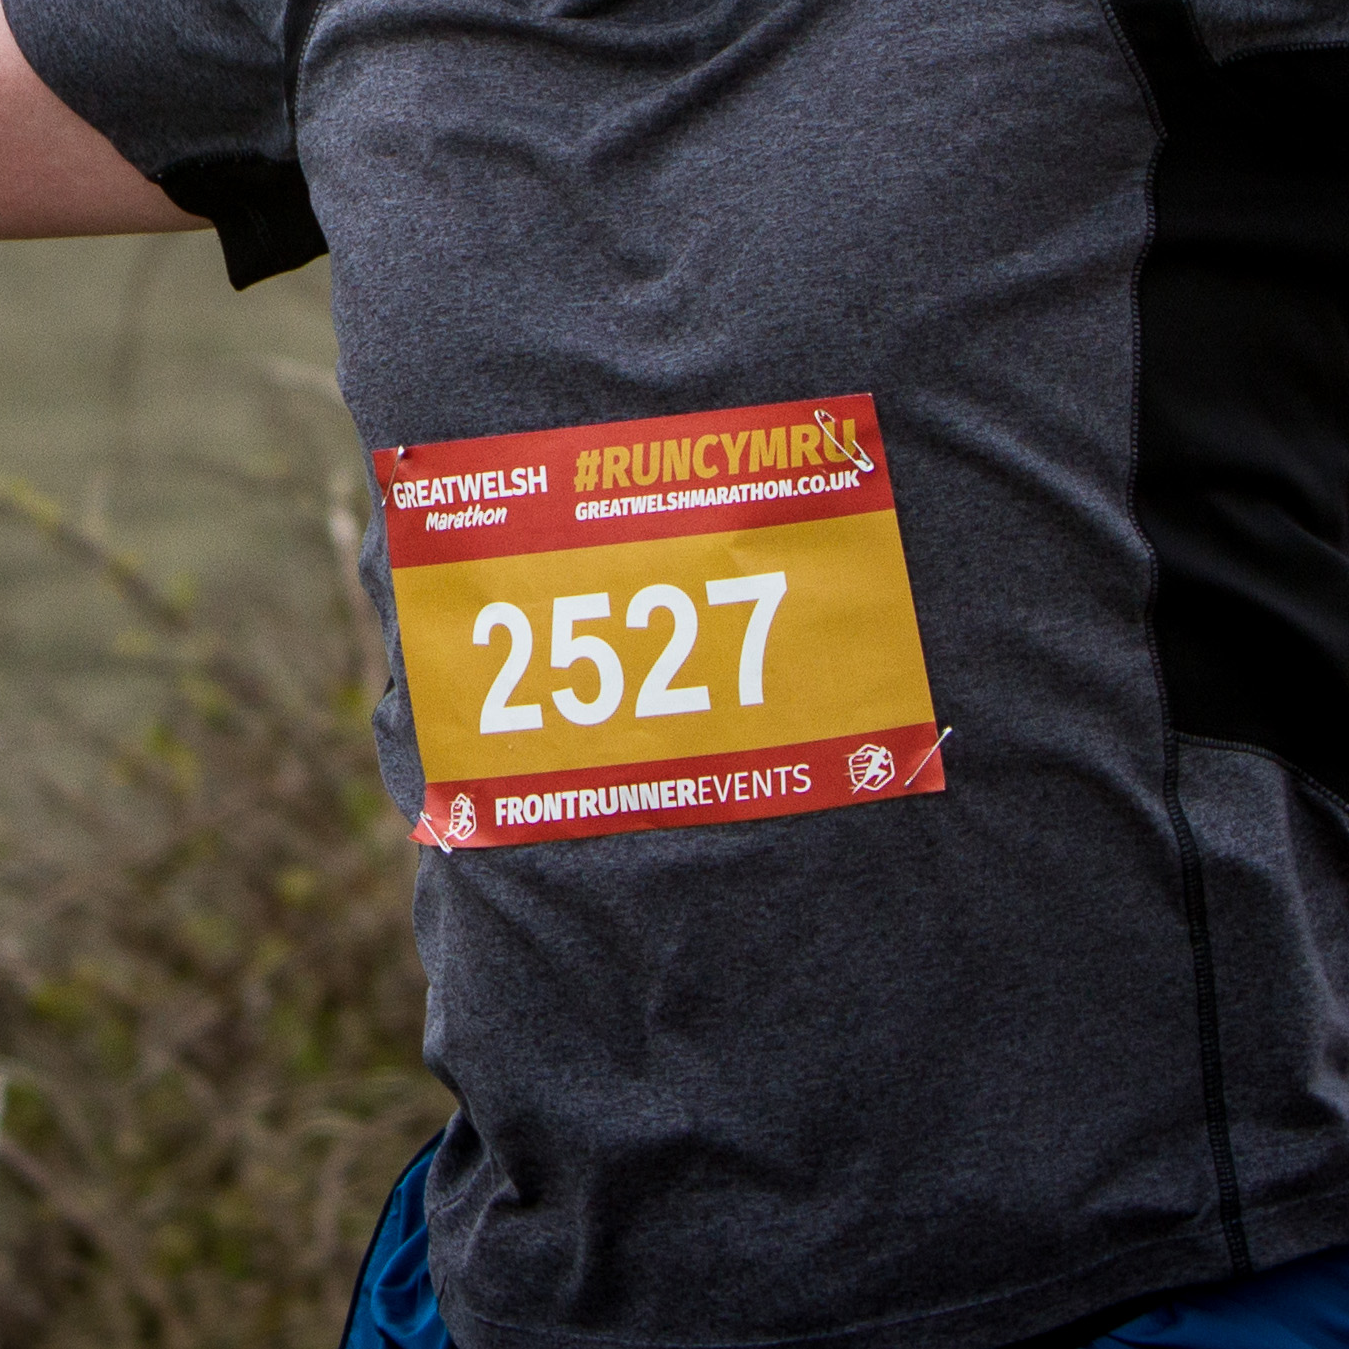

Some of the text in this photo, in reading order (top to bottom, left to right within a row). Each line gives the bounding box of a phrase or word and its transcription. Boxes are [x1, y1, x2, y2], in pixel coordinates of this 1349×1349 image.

[573, 419, 856, 493] #RUNCYMRU
[392, 465, 548, 509] GREATWELSH
[574, 468, 860, 521] GREATWELSHMARATHON.CO.UK
[425, 503, 508, 532] Marathon
[472, 571, 788, 735] 2527
